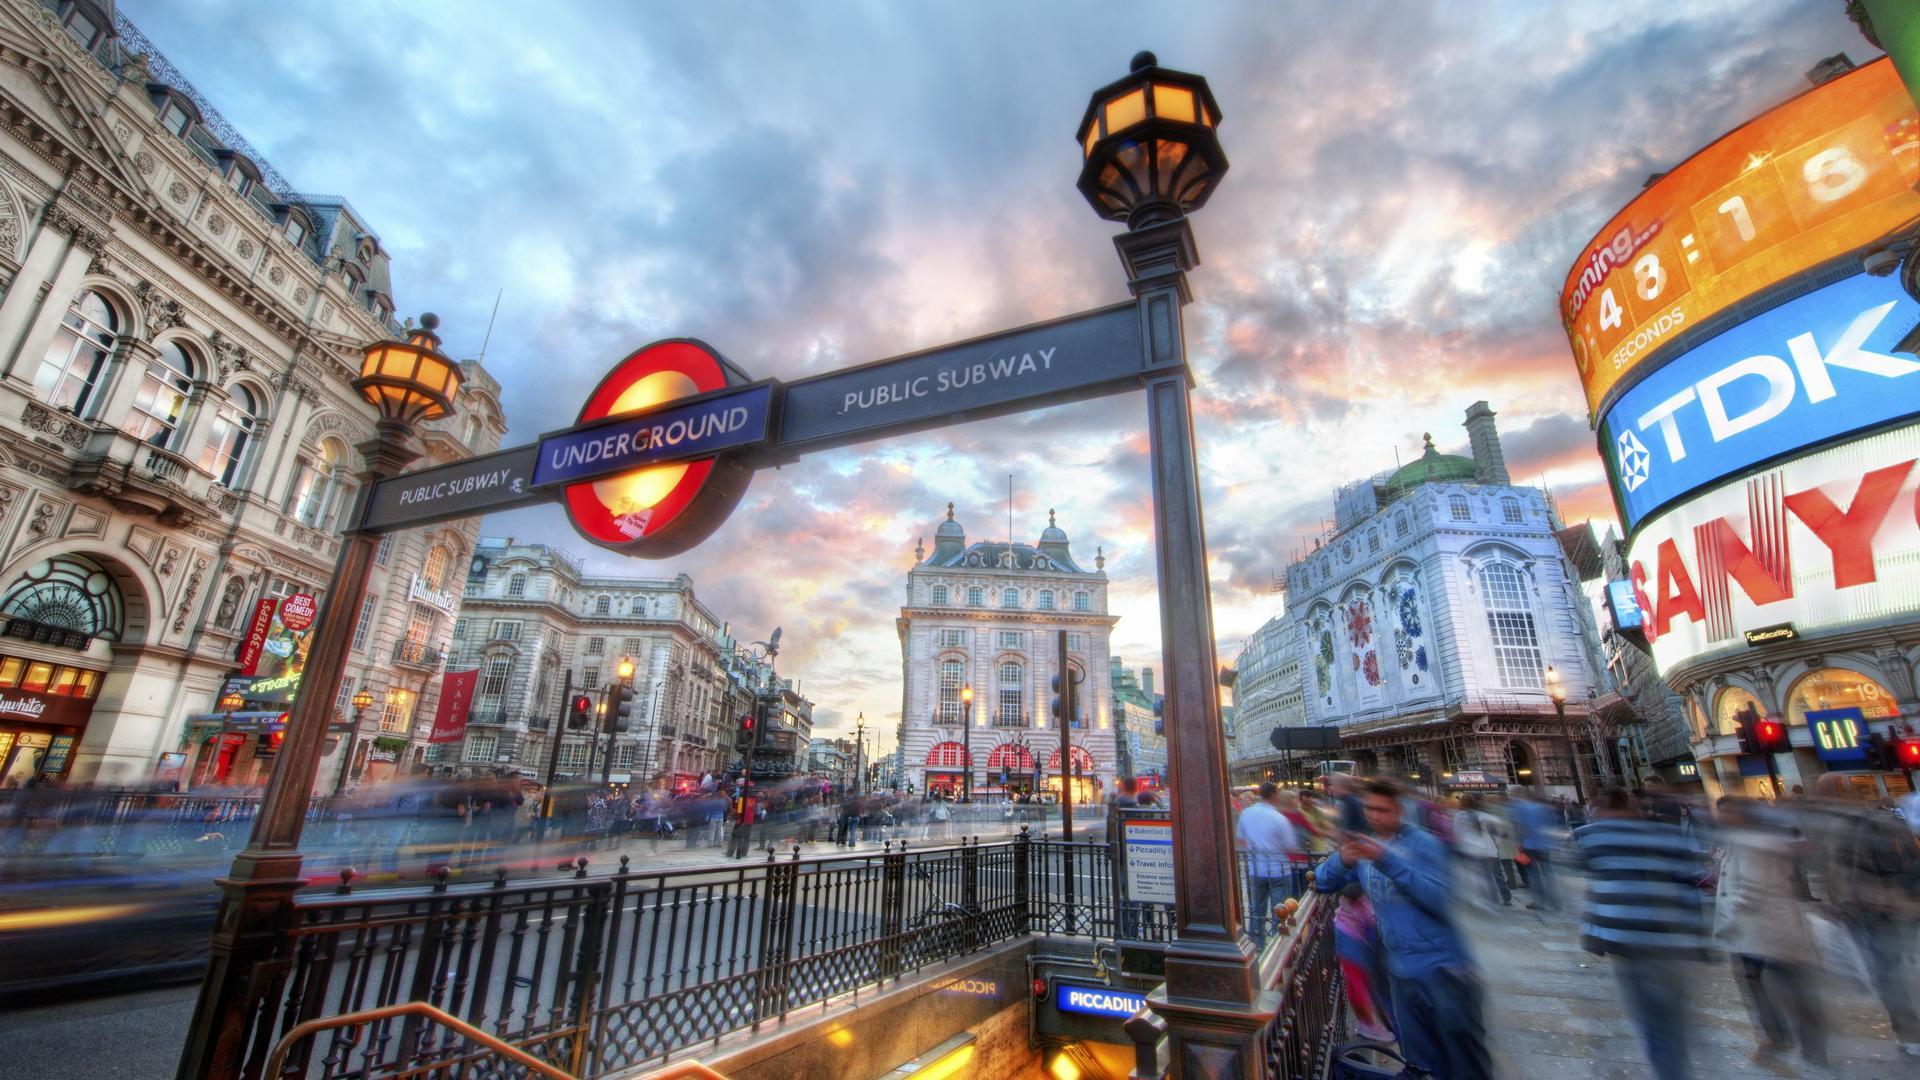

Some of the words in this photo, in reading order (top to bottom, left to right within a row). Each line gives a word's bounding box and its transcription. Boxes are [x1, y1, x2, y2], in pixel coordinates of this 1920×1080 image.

[1613, 307, 1685, 369] SECONDS
[843, 376, 930, 413] PUBLIC
[937, 346, 1057, 393] SUBWAY
[1637, 299, 1920, 464] TDK
[551, 406, 749, 470] UNDERGROUND
[399, 483, 447, 506] PUBLIC
[448, 468, 511, 496] SUBWAY
[1631, 457, 1920, 645] SANY
[285, 603, 315, 618] COMEDY
[294, 595, 312, 607] BEST
[252, 632, 260, 649] 39
[450, 677, 464, 723] SALE
[1816, 719, 1859, 750] GAP
[1679, 765, 1696, 776] GAP
[1135, 846, 1167, 855] Piccadilly
[1136, 860, 1157, 868] Travel
[1070, 991, 1147, 1013] PICCADILL
